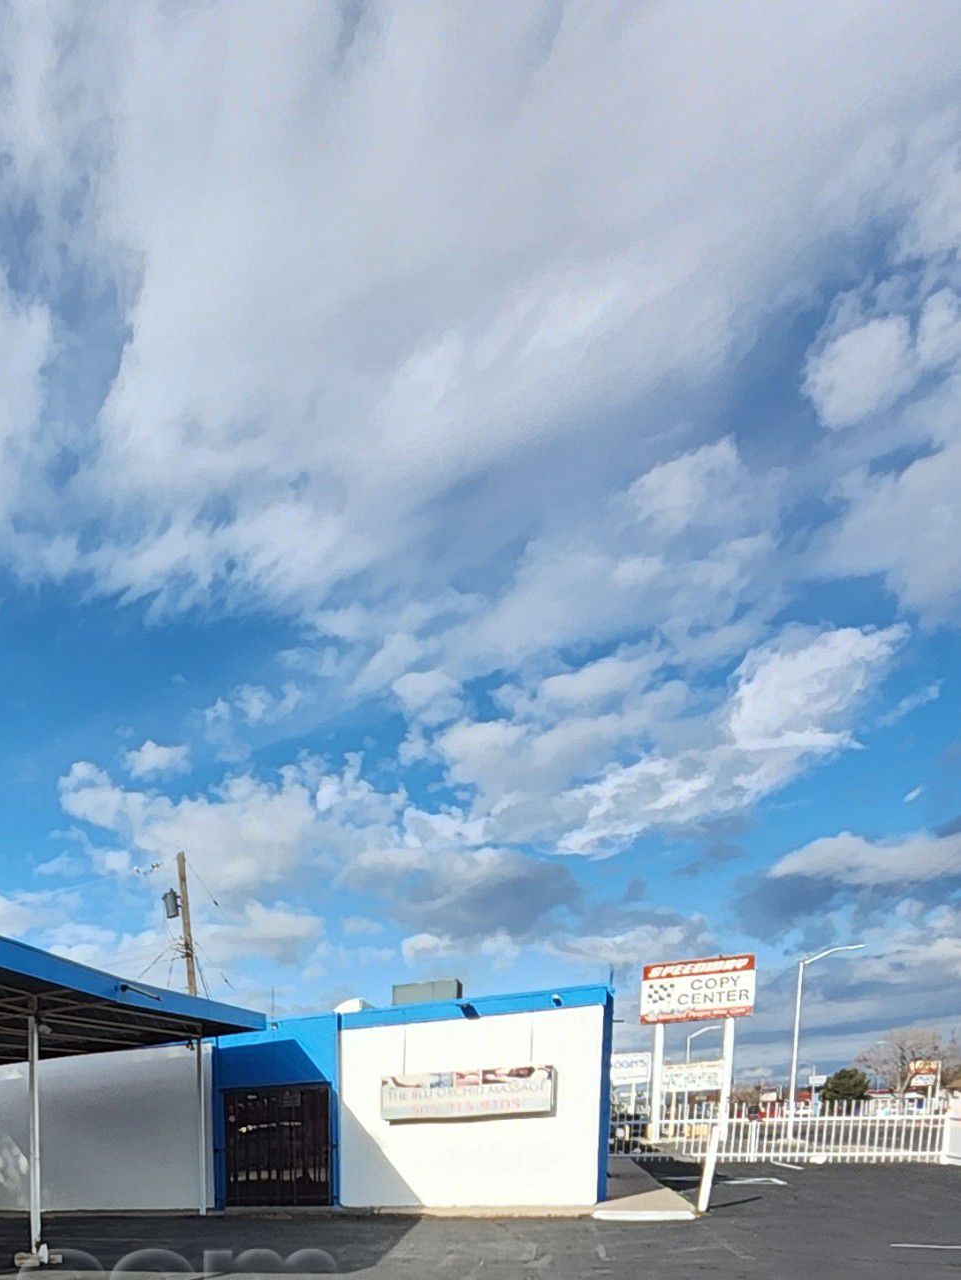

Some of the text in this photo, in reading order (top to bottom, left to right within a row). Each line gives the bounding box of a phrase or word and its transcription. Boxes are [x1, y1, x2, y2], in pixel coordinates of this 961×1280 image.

[690, 975, 741, 991] COPY
[677, 988, 750, 1005] CENTER
[488, 1078, 546, 1096] MASSAGE
